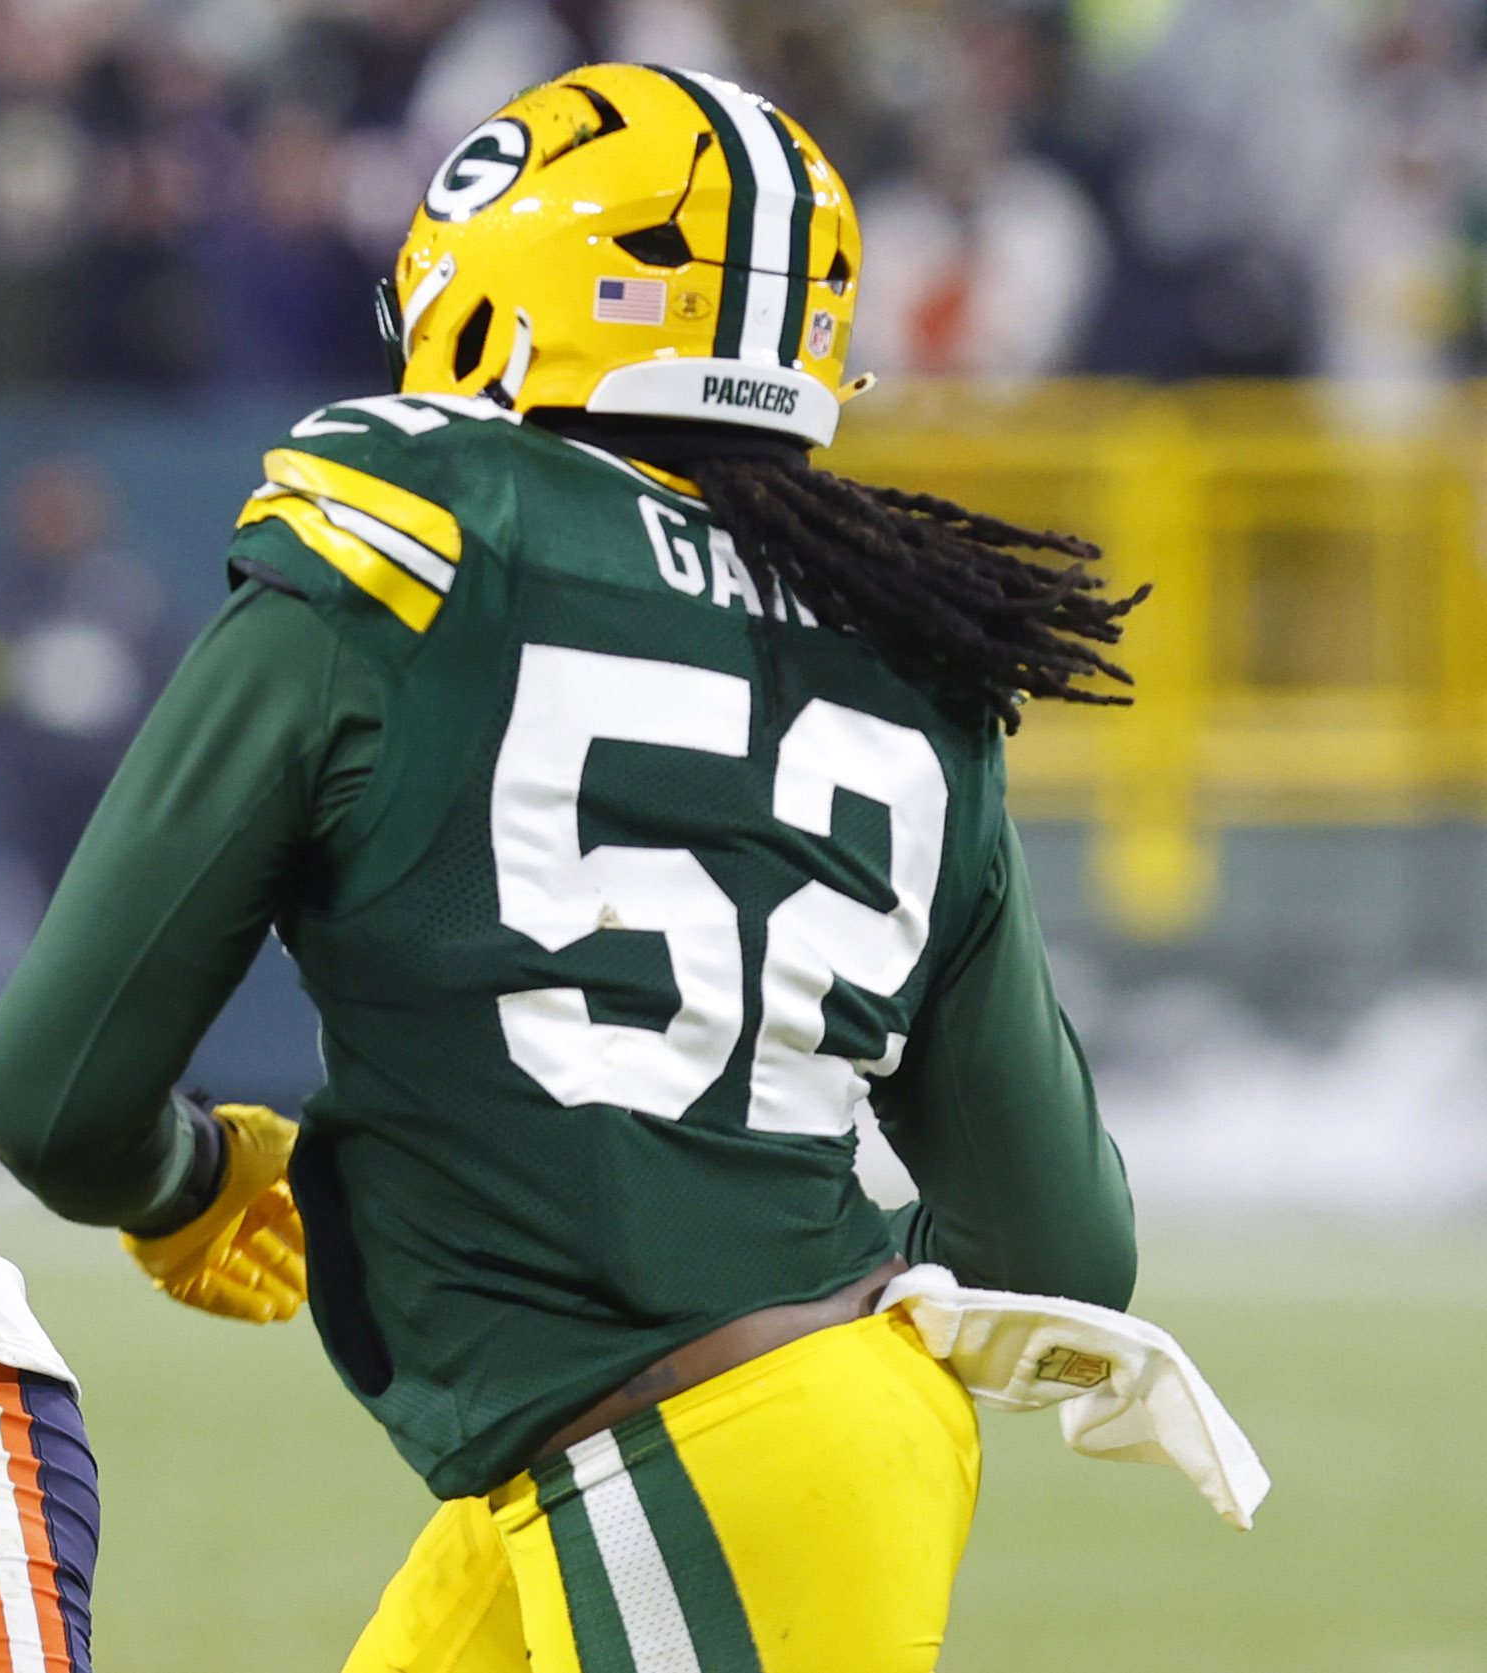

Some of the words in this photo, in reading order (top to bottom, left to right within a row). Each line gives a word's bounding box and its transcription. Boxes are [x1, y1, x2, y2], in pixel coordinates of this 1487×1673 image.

[424, 118, 527, 221] G
[700, 375, 801, 417] PACKERS
[490, 642, 949, 1136] 52
